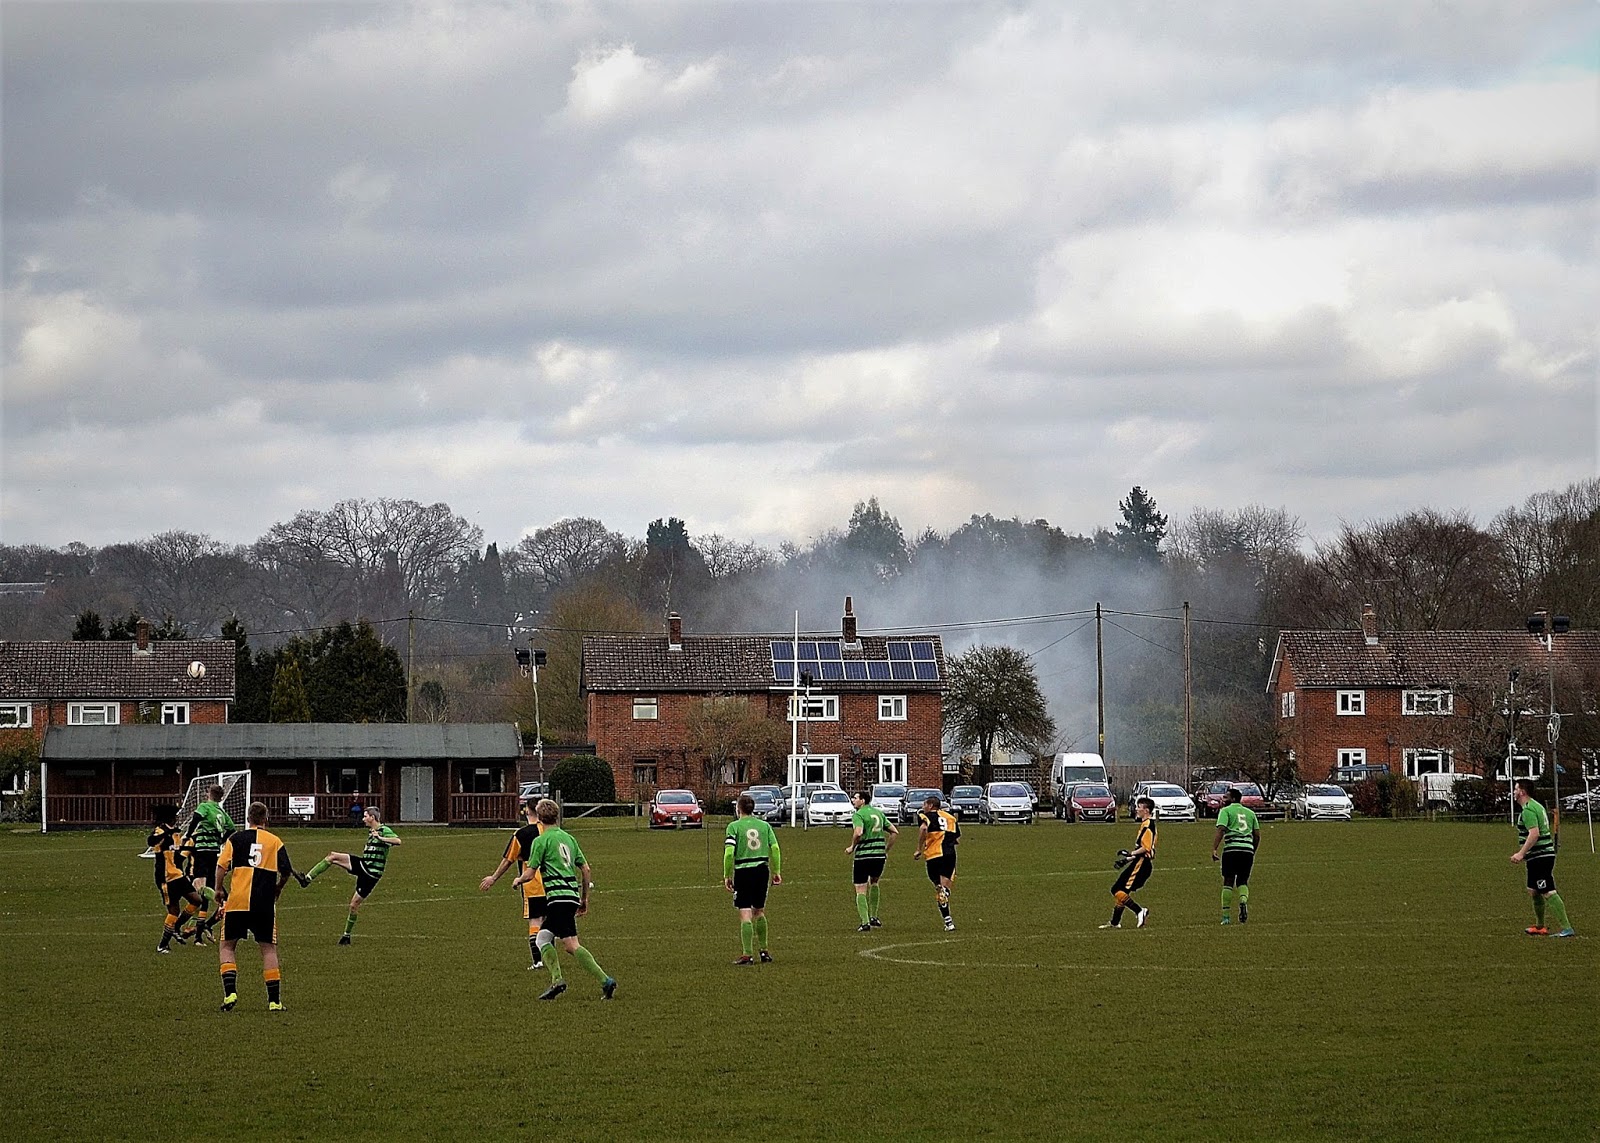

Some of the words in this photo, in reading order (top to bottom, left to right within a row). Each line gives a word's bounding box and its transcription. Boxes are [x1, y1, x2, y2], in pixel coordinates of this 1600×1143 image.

[870, 814, 881, 832] 2
[937, 816, 948, 831] 9
[1237, 814, 1248, 831] 5
[746, 828, 761, 850] 8
[248, 843, 263, 867] 5
[558, 842, 571, 868] 9
